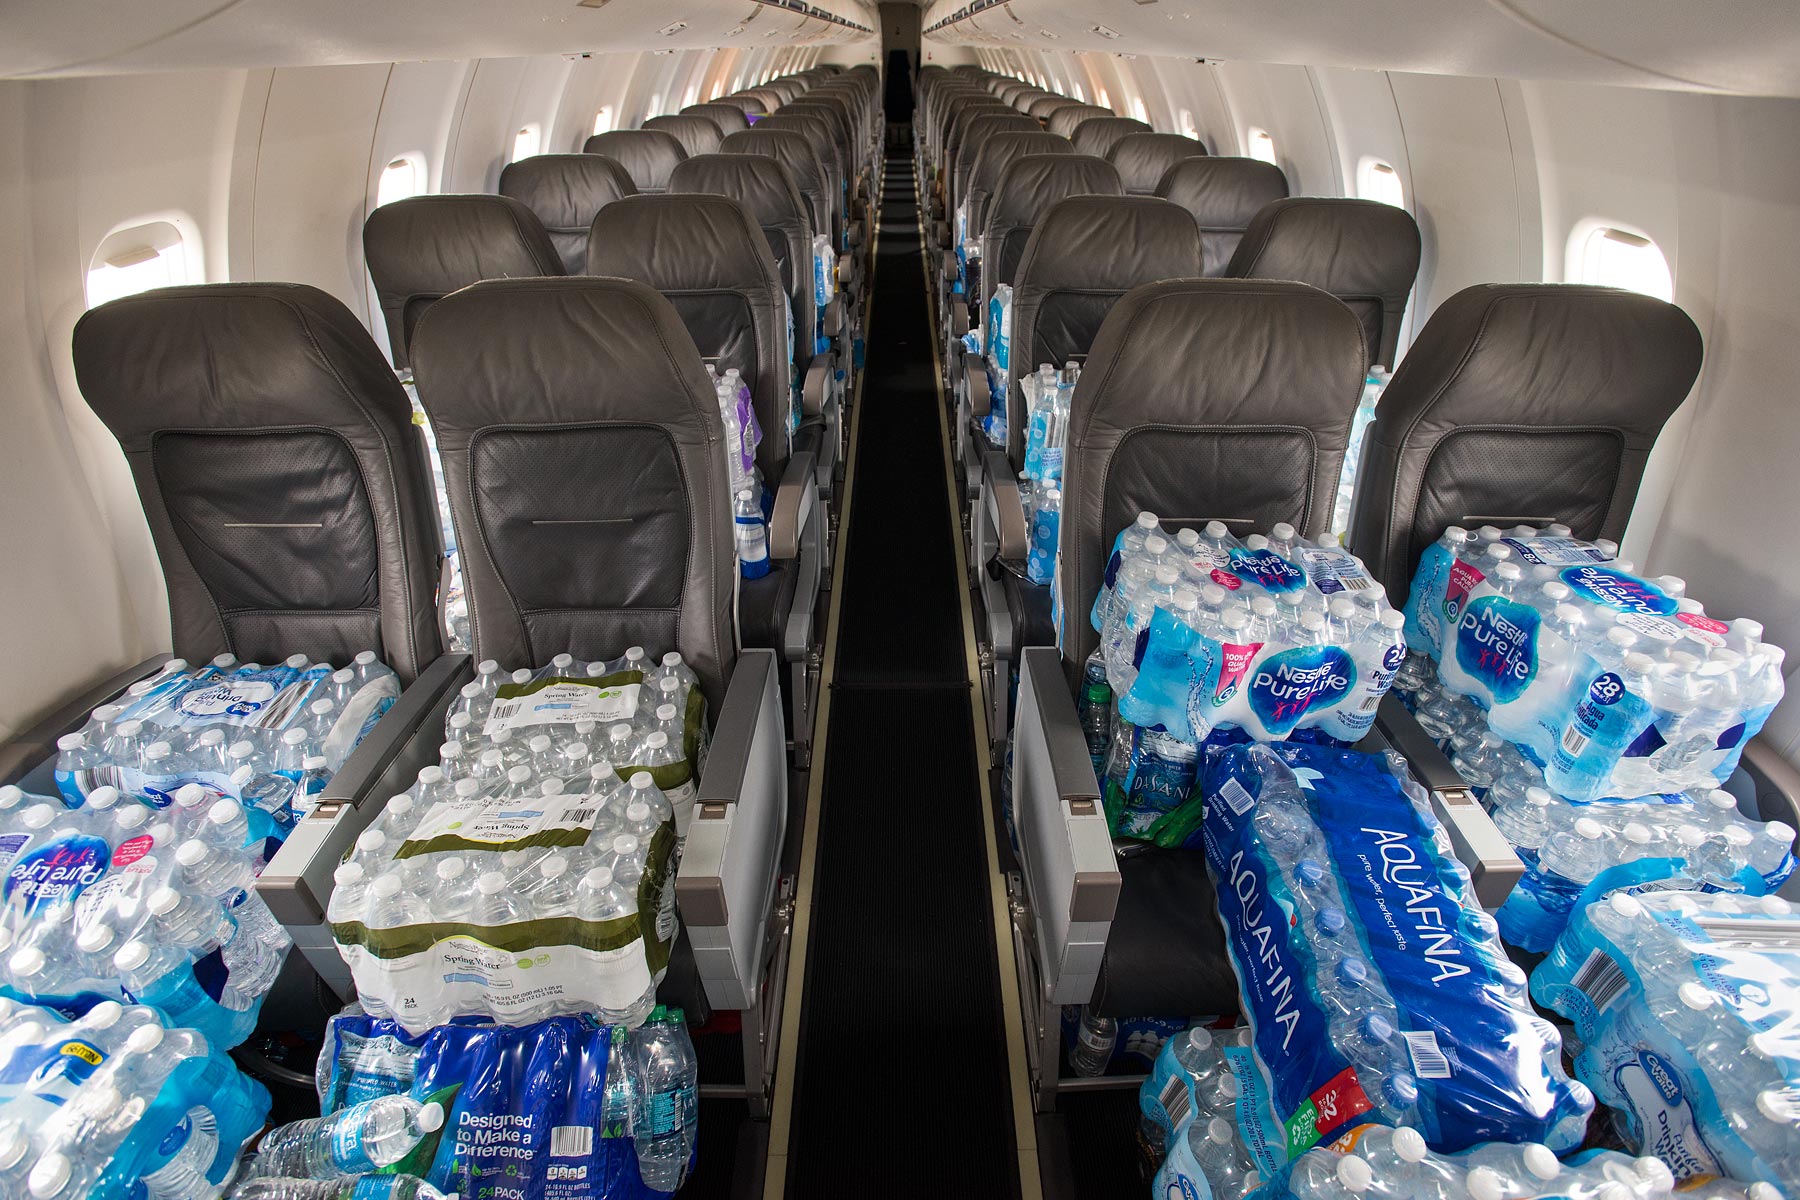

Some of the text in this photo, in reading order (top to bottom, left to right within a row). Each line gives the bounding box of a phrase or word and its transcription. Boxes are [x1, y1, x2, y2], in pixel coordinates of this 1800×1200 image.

[1271, 562, 1301, 577] Life
[1523, 552, 1541, 563] 28
[1453, 567, 1472, 580] AGUA
[1575, 576, 1631, 609] Nestlé
[1580, 567, 1664, 616] Pure Life
[1481, 607, 1529, 647] Nestlé
[1388, 647, 1406, 663] 24
[1460, 612, 1529, 680] Pure Life
[1253, 672, 1348, 700] Pure Life
[1276, 661, 1334, 684] Nestlé
[1594, 675, 1621, 698] 28
[1586, 701, 1606, 721] Agua
[1133, 774, 1191, 800] DASANI
[1207, 796, 1223, 818] Drinking
[1221, 815, 1235, 832] Water
[1211, 793, 1227, 812] Purified
[11, 858, 104, 886] Pure Life
[1357, 853, 1407, 951] pure water, perfect taste
[1360, 827, 1471, 983] AQUAFINA
[444, 954, 501, 970] Spring Water
[1230, 850, 1300, 1051] AQUAFINA
[1646, 1054, 1680, 1097] Great
[1651, 1067, 1672, 1100] Value
[1324, 1089, 1338, 1121] 32
[458, 1111, 534, 1130] Designed
[456, 1128, 532, 1146] to Make a
[1253, 1139, 1265, 1158] TOTAL
[1657, 1109, 1692, 1178] Drinkin
[454, 1143, 534, 1161] Difference
[1673, 1133, 1705, 1174] Purifie
